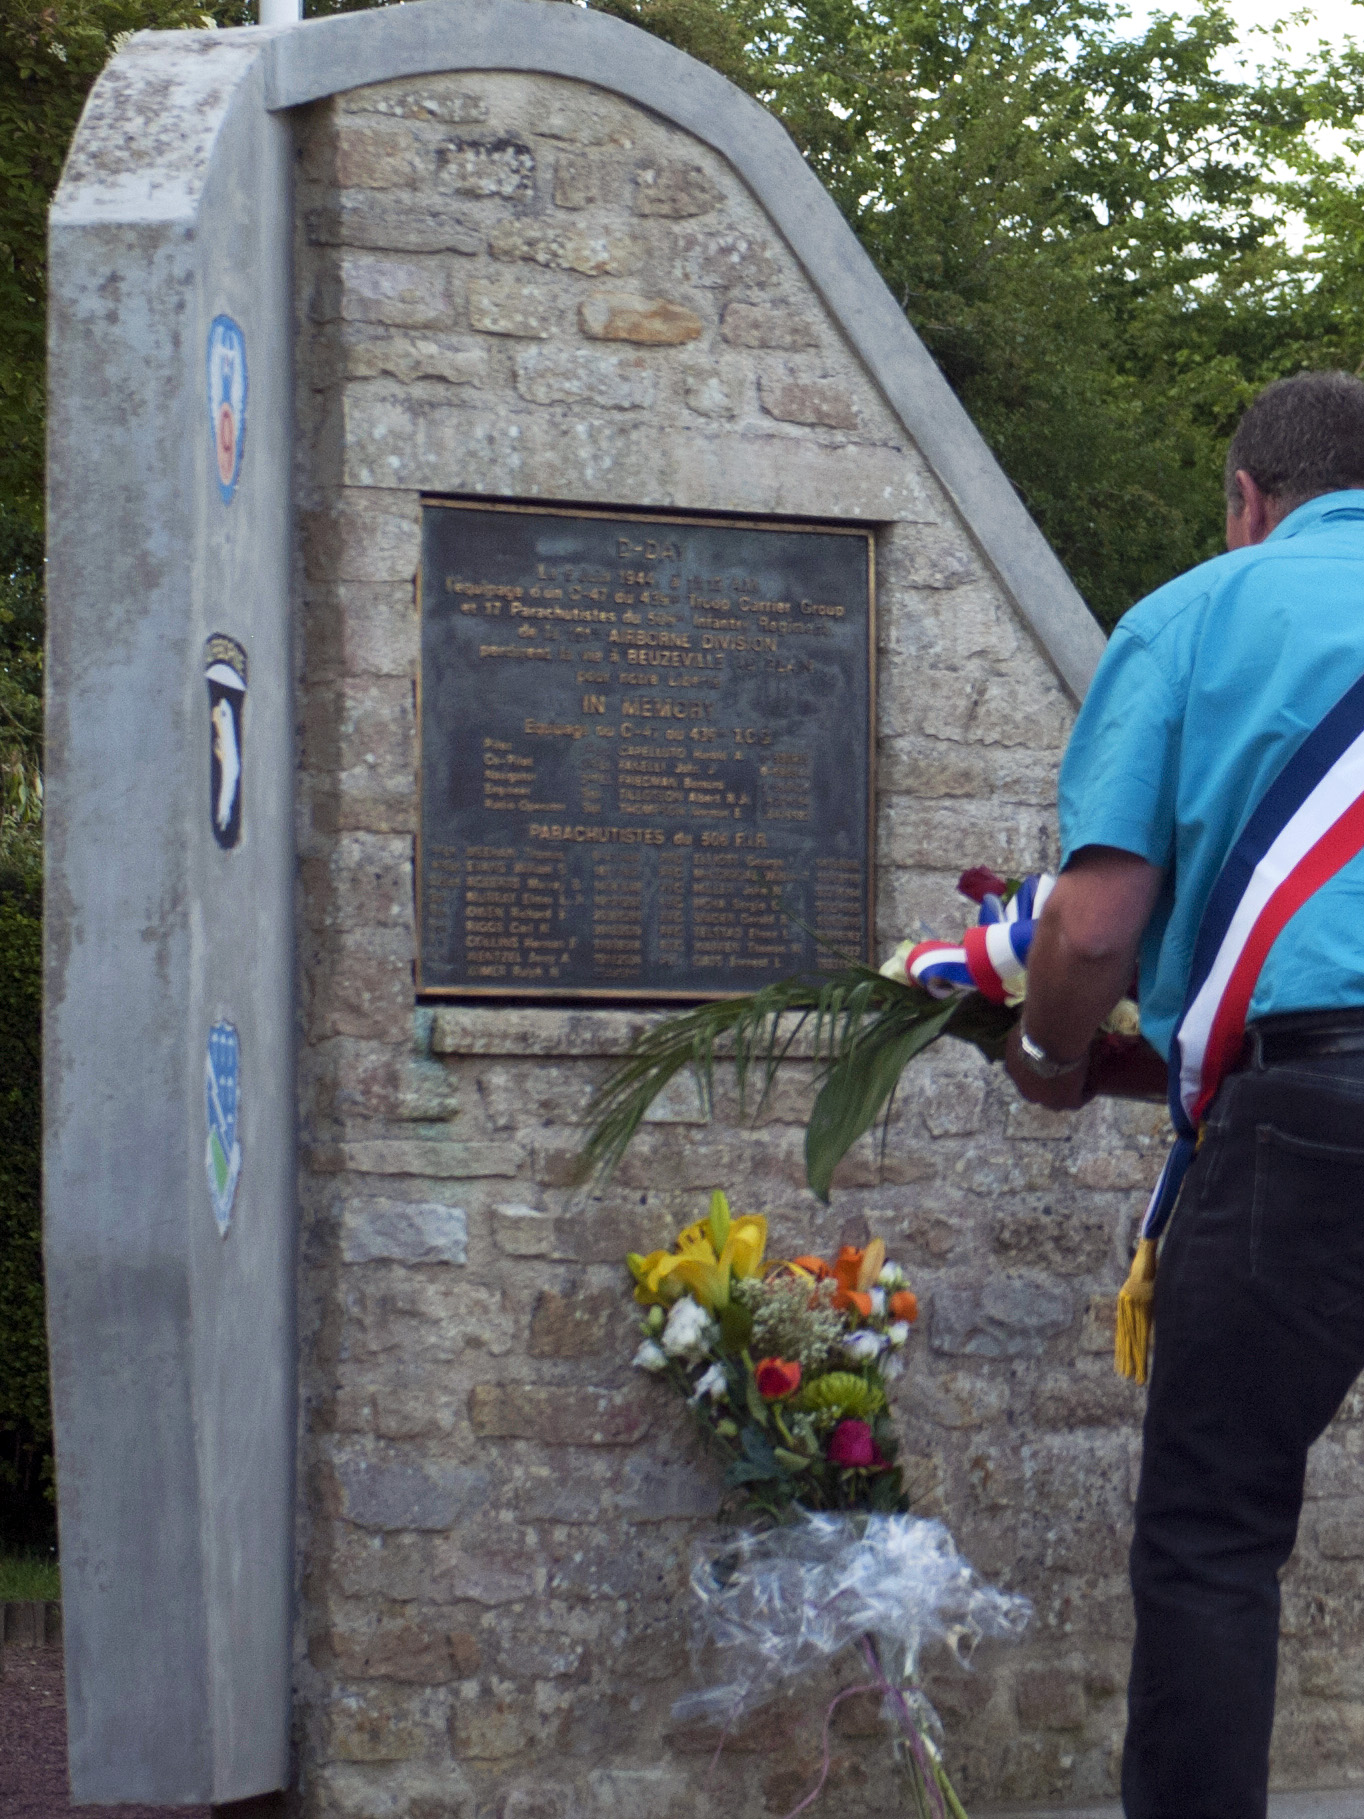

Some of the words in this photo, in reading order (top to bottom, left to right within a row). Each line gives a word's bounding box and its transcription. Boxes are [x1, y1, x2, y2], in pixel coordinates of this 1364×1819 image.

[617, 538, 681, 562] D-DAY
[619, 570, 654, 586] 1944
[510, 601, 617, 622] Parachutistes
[689, 593, 731, 611] Troop
[738, 596, 792, 612] Carrier
[801, 599, 845, 618] Group
[608, 629, 692, 648] AIRBORNE
[701, 633, 778, 651] DIVISION
[626, 648, 725, 669] BEUZEVILLE
[581, 694, 606, 714] IN
[621, 696, 715, 719] MEMORY
[529, 823, 665, 845] PARACHUTISTES
[672, 831, 693, 846] du
